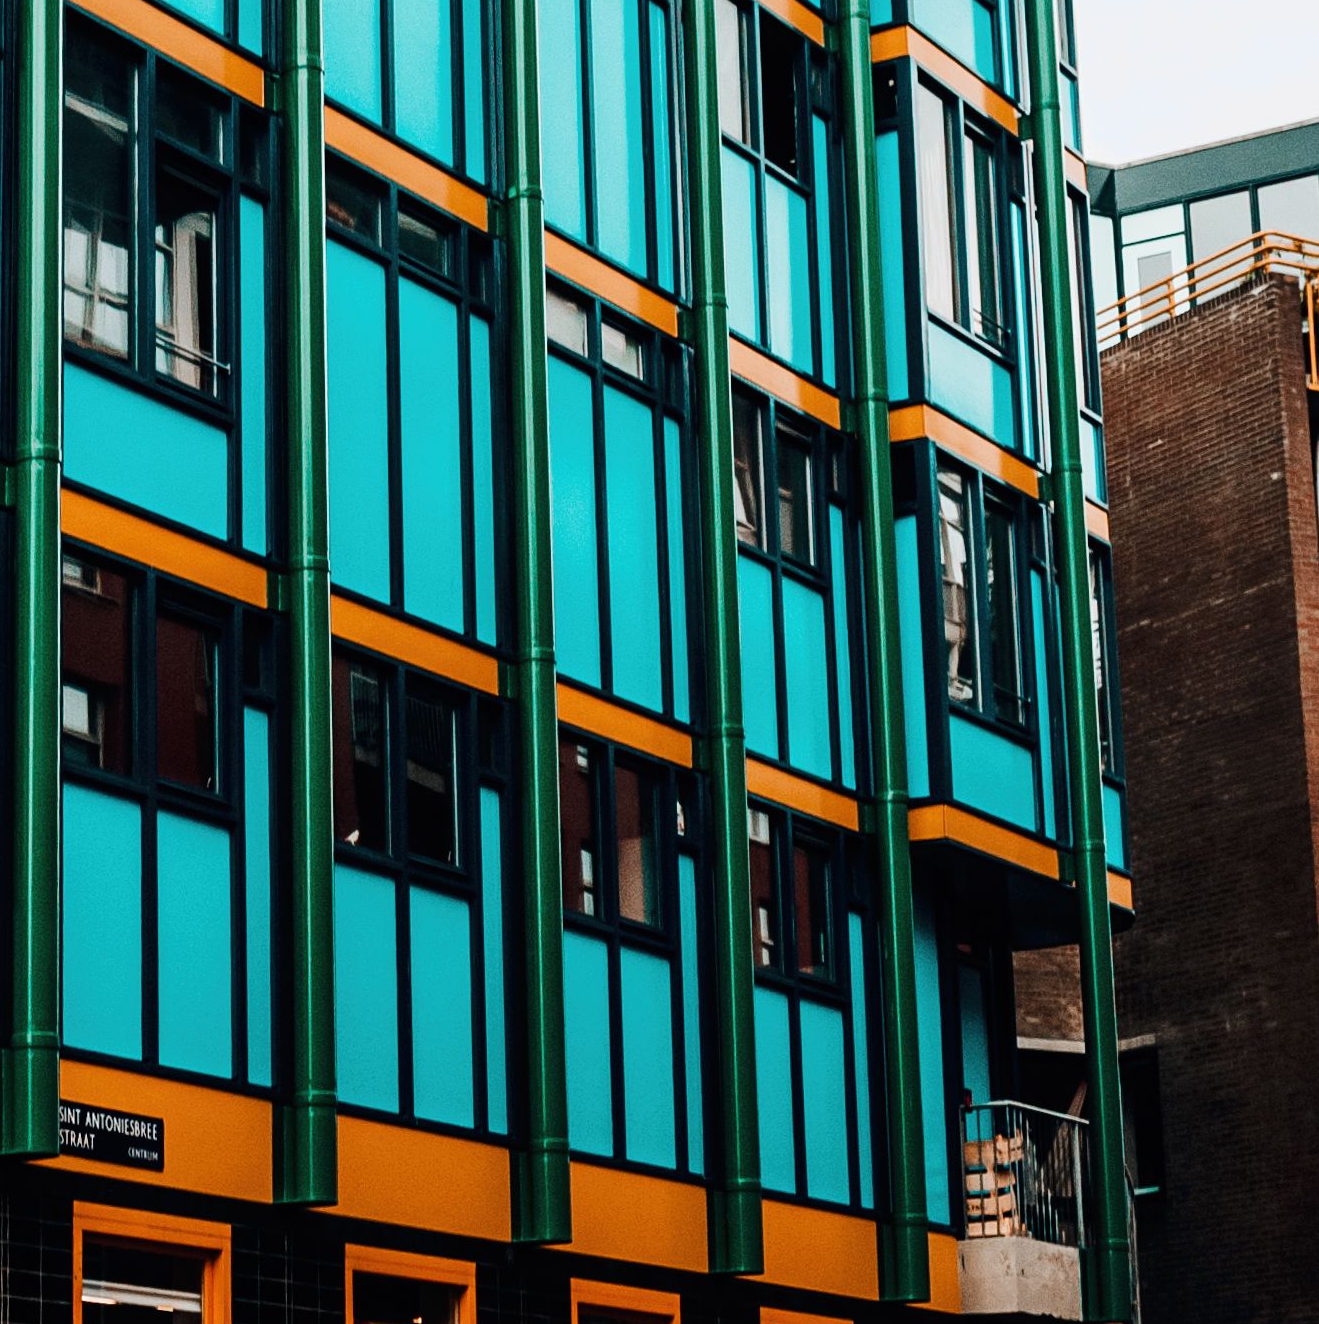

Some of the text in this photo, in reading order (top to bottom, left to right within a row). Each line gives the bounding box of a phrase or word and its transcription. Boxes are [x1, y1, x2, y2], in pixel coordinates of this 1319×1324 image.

[59, 1106, 158, 1141] SINT ANTONIESBREE
[59, 1128, 158, 1161] STRAAT CENTRUM
